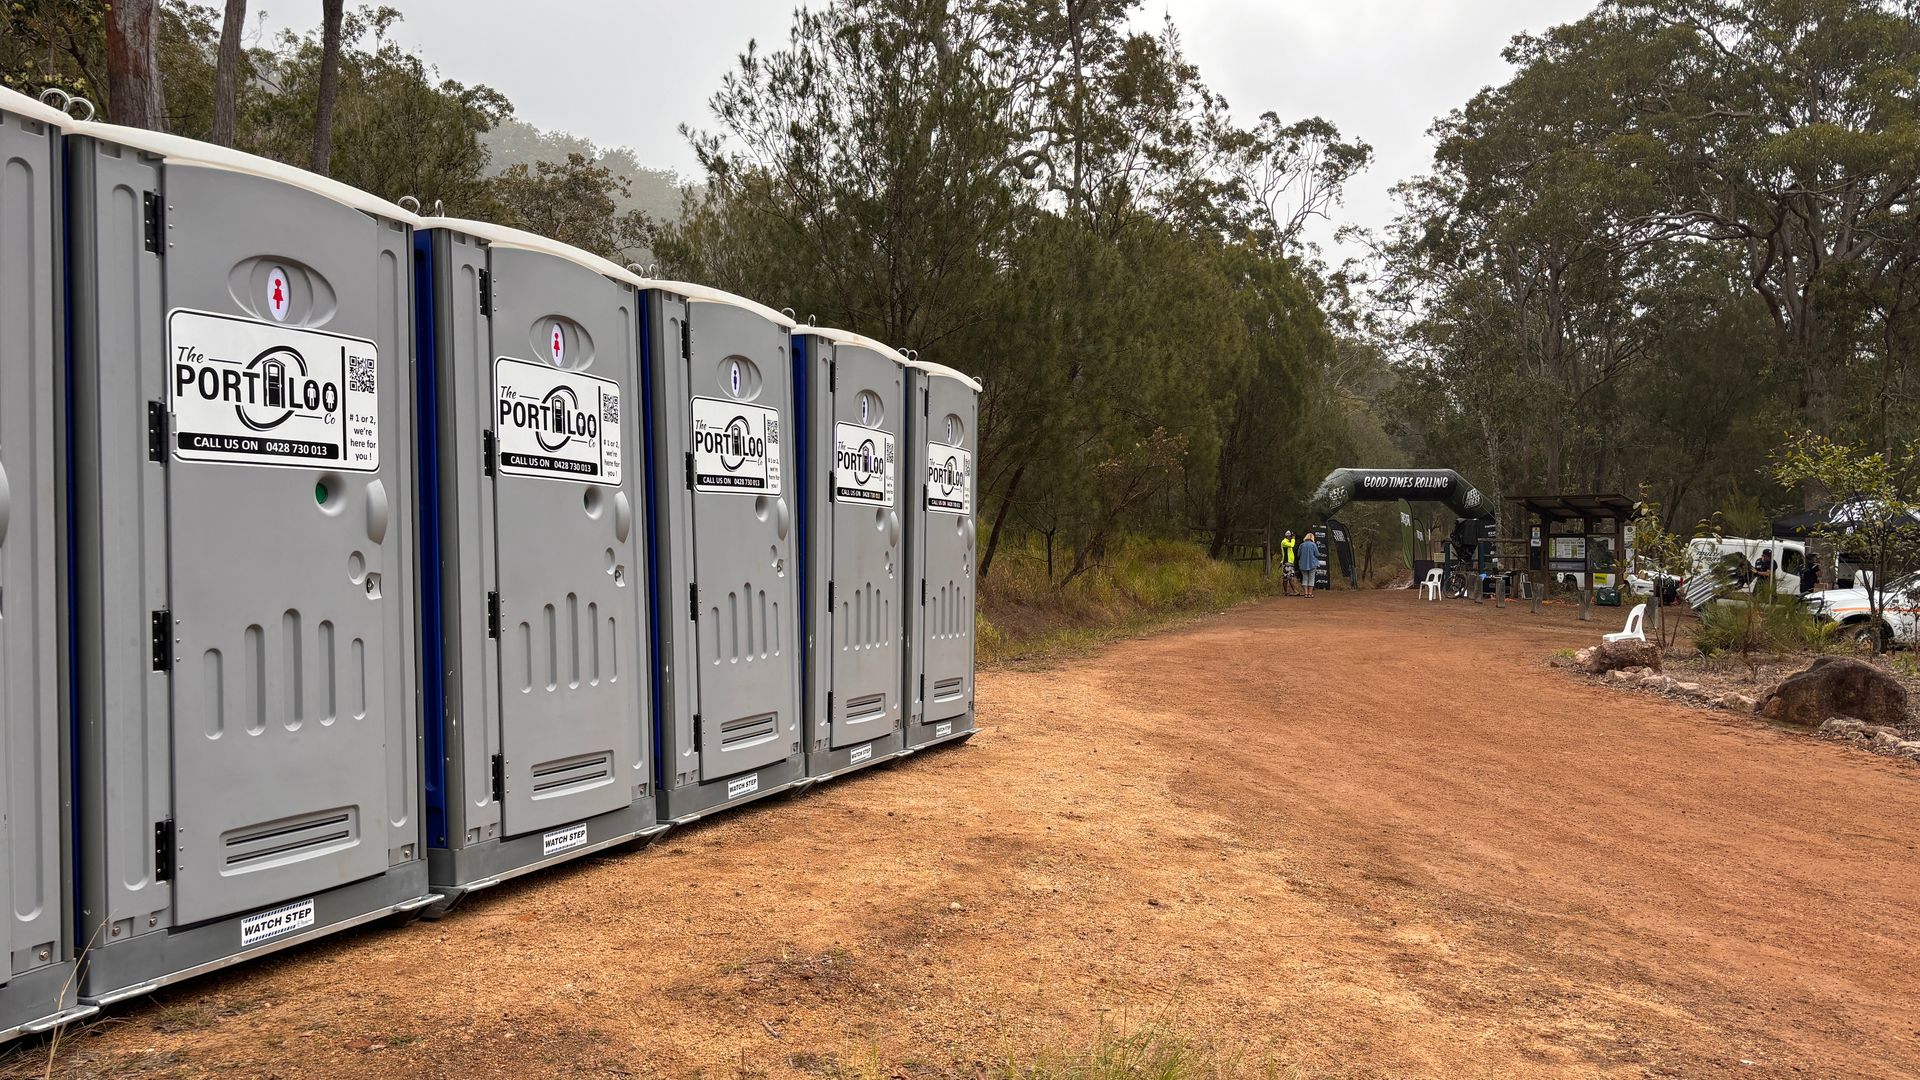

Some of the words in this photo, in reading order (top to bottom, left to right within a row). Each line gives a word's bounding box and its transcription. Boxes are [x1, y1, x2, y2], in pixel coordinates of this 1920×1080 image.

[178, 346, 204, 364] The
[500, 386, 517, 399] The
[324, 413, 336, 425] Co
[349, 413, 354, 421] #
[355, 414, 359, 422] 1
[370, 415, 376, 425] 2,
[695, 419, 707, 430] The
[354, 427, 373, 436] we're
[193, 437, 221, 448] CALL
[224, 439, 239, 449] US
[241, 440, 258, 450] ON
[266, 442, 290, 453] 0428
[292, 444, 309, 454] 730
[311, 445, 327, 456] 013
[350, 438, 366, 447] here
[367, 440, 376, 449] for
[588, 439, 596, 448] Co
[355, 453, 368, 461] you
[510, 456, 528, 465] CALL
[528, 457, 538, 466] US
[540, 459, 550, 467] ON
[554, 460, 569, 469] 0428
[570, 463, 580, 471] 730
[581, 464, 591, 472] 013
[703, 476, 716, 484] CALL
[724, 477, 732, 485] ON
[1364, 476, 1388, 488] GOOD
[1388, 477, 1413, 488] TIMES
[1414, 477, 1449, 488] ROLLING
[545, 834, 568, 848] WATCH
[569, 830, 585, 840] STEP
[244, 917, 282, 937] WATCH
[285, 908, 311, 923] STEP
